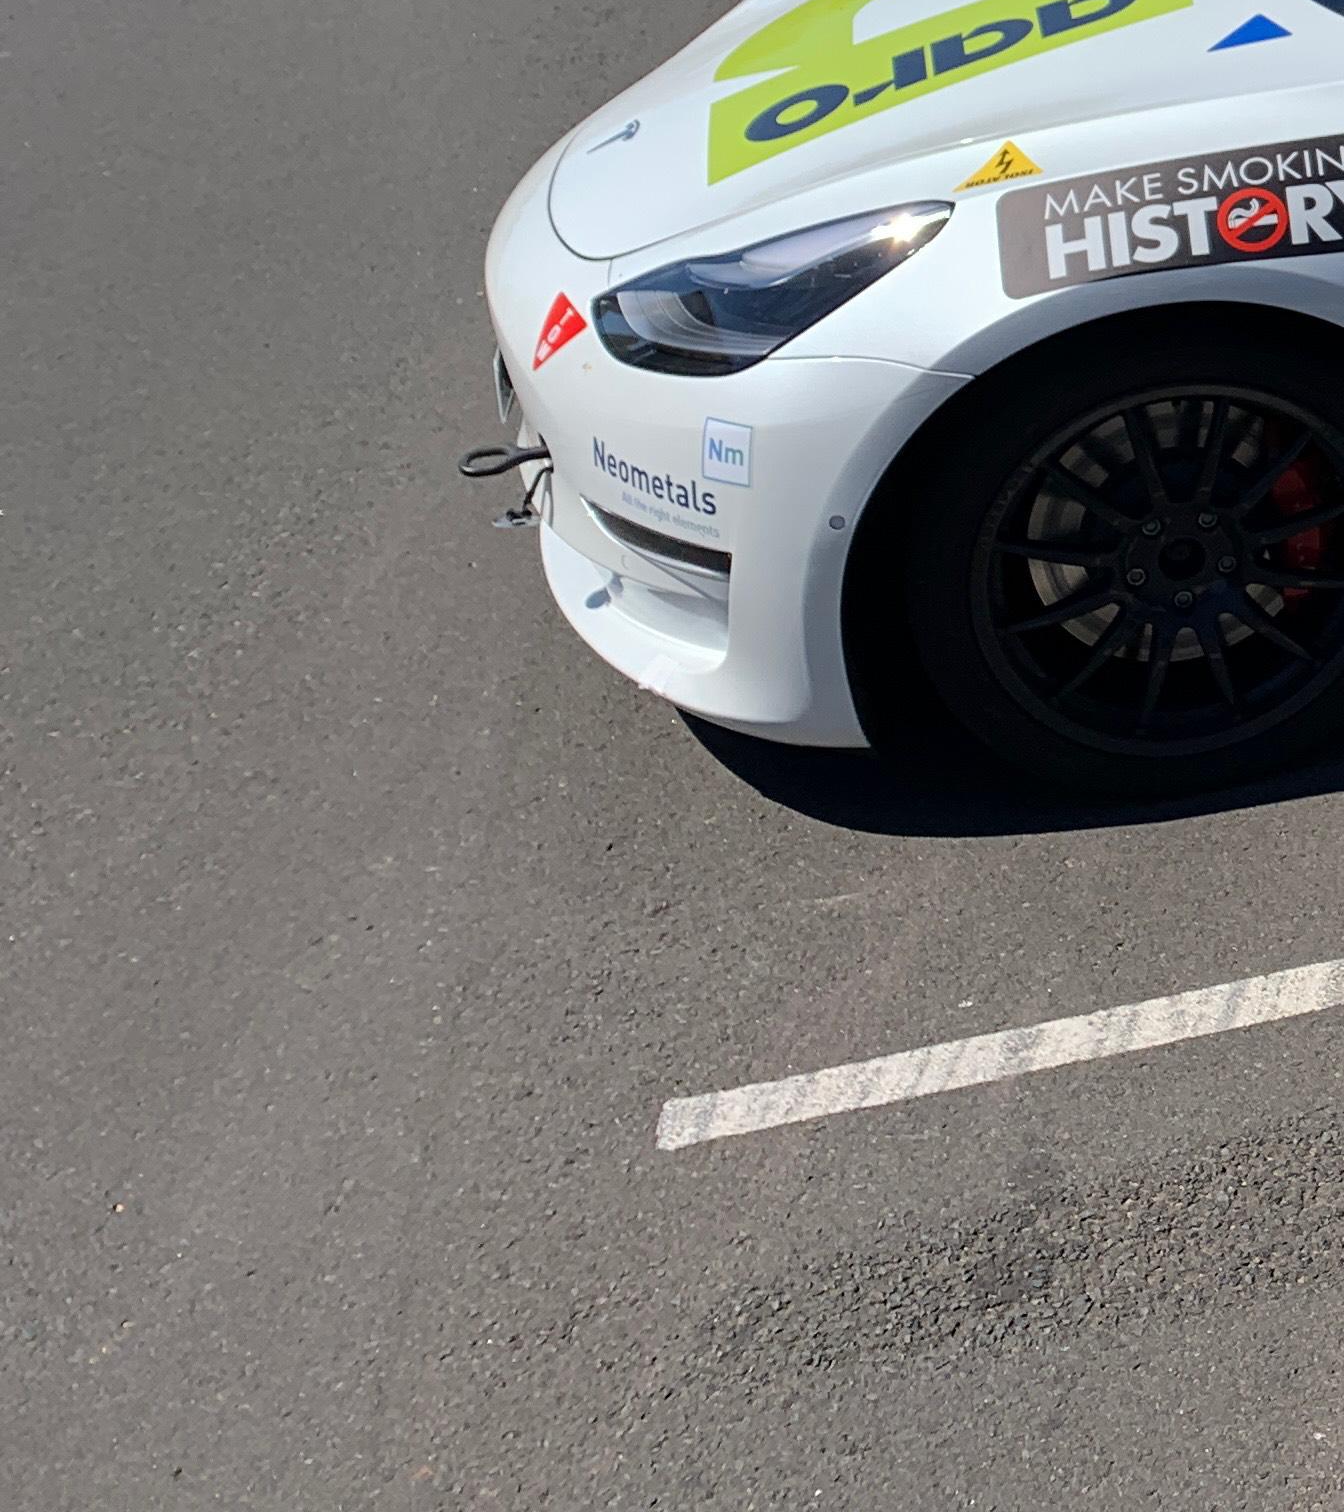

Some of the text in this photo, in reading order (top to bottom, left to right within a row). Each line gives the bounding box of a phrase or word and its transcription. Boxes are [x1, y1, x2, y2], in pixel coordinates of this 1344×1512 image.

[1044, 172, 1163, 221] MAKE
[536, 306, 575, 361] TOW
[592, 436, 717, 516] Neometals
[708, 438, 744, 467] Nm
